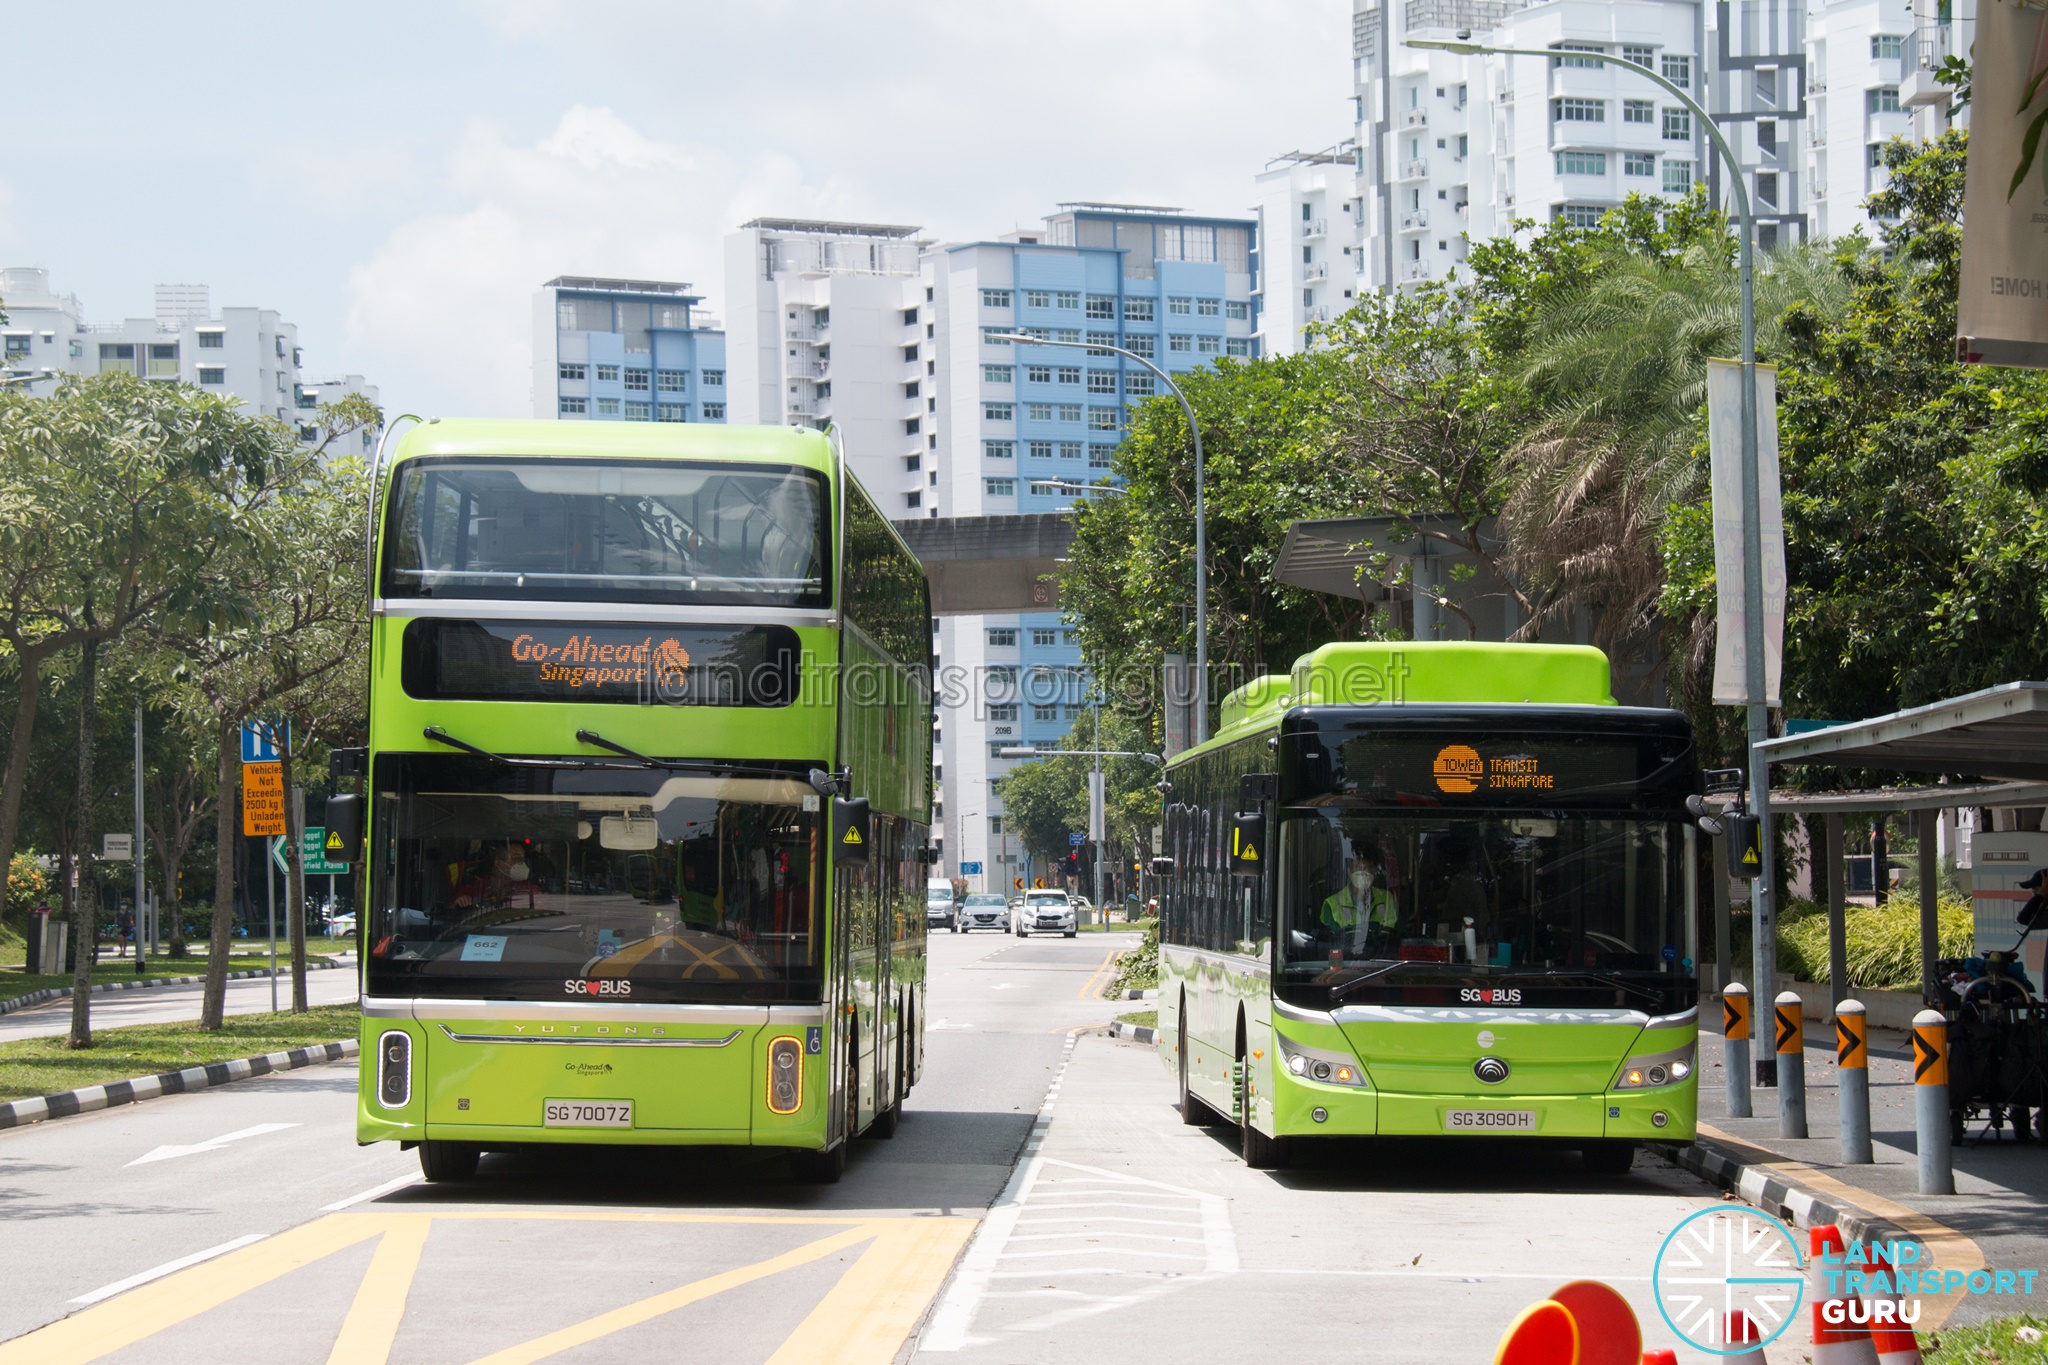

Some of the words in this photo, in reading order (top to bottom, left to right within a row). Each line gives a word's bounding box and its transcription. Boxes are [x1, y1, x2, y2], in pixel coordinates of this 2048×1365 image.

[511, 634, 652, 663] Go-Ahead
[540, 662, 647, 688] Singapore
[995, 726, 1012, 735] 209B
[250, 765, 283, 775] Vehicles
[1443, 758, 1481, 771] TOWER
[1489, 759, 1538, 772] TRANSIT
[259, 776, 274, 786] Not
[1489, 775, 1553, 788] SINGAPORE
[246, 789, 284, 798] Exceedin
[246, 800, 266, 810] 2500
[269, 800, 278, 811] kg
[250, 812, 284, 821] Unladen
[254, 823, 281, 834] Weight
[514, 1025, 665, 1035] YUTONG
